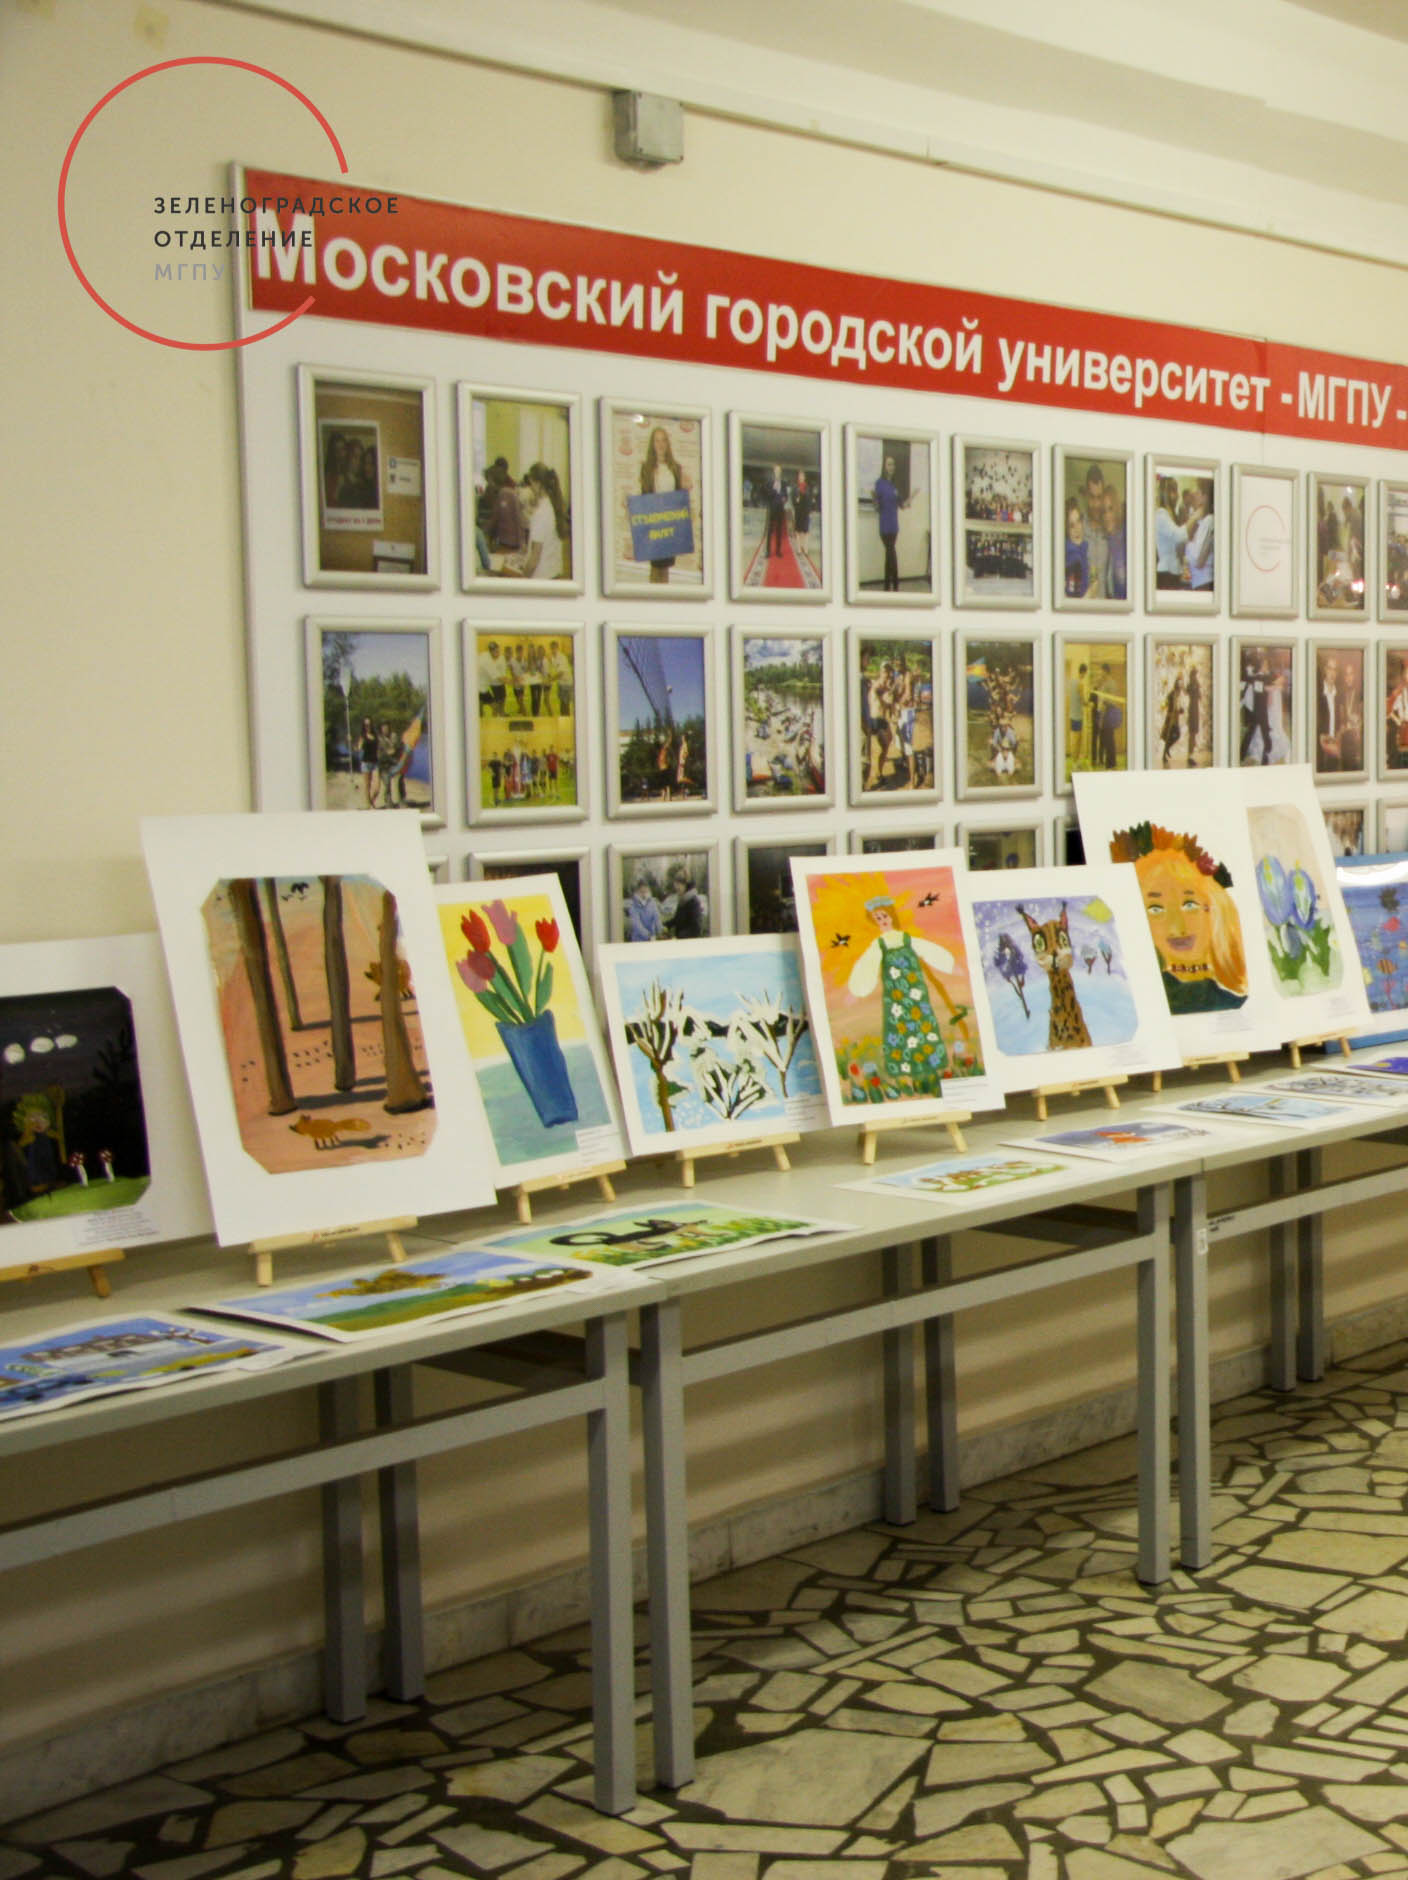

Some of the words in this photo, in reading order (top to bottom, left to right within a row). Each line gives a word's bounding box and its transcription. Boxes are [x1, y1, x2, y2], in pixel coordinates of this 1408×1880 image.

[254, 206, 685, 336] Московский
[705, 293, 984, 375] городской
[998, 336, 1271, 408] университет
